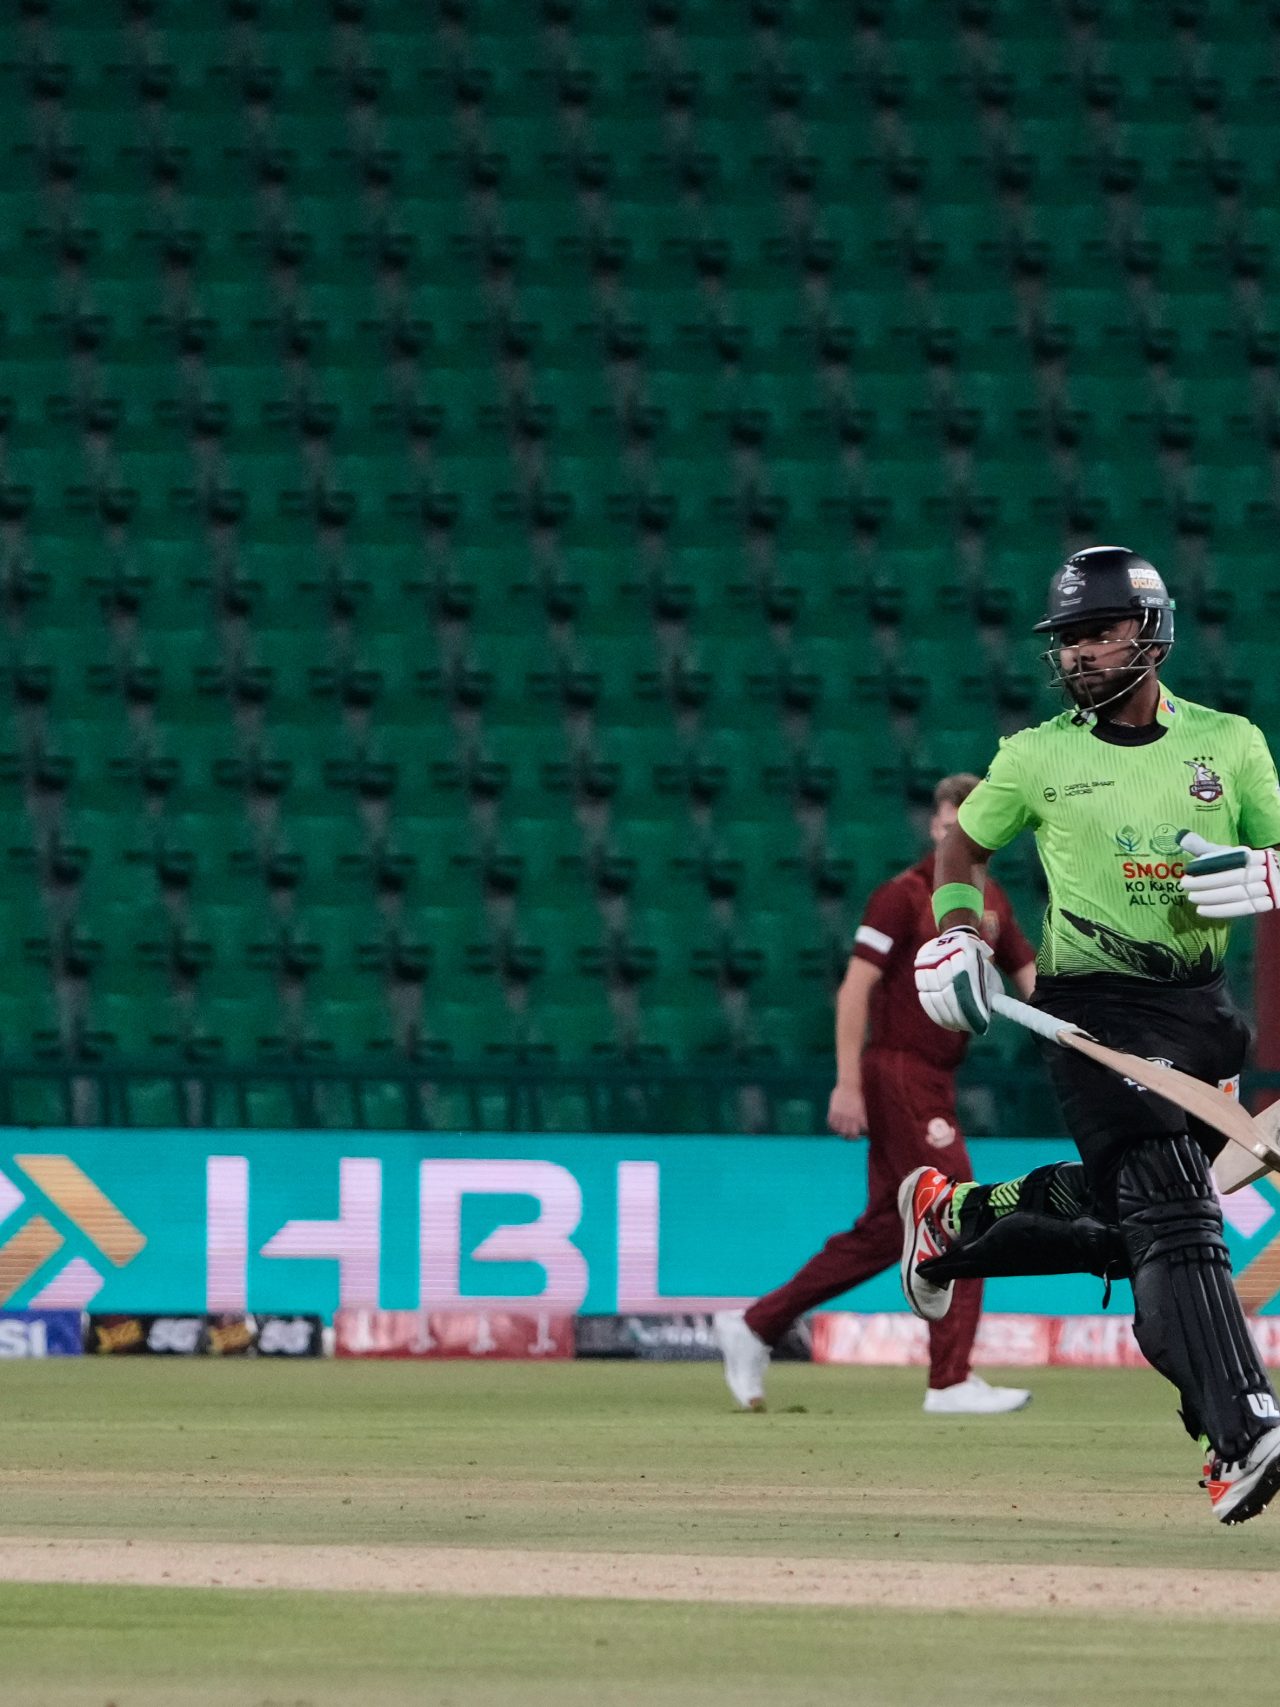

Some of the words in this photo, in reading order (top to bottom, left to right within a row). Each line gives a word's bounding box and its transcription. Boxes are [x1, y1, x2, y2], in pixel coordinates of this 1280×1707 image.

[1125, 881, 1145, 892] KO
[1129, 895, 1155, 906] ALL
[936, 935, 959, 946] SF
[206, 1155, 763, 1313] HBL
